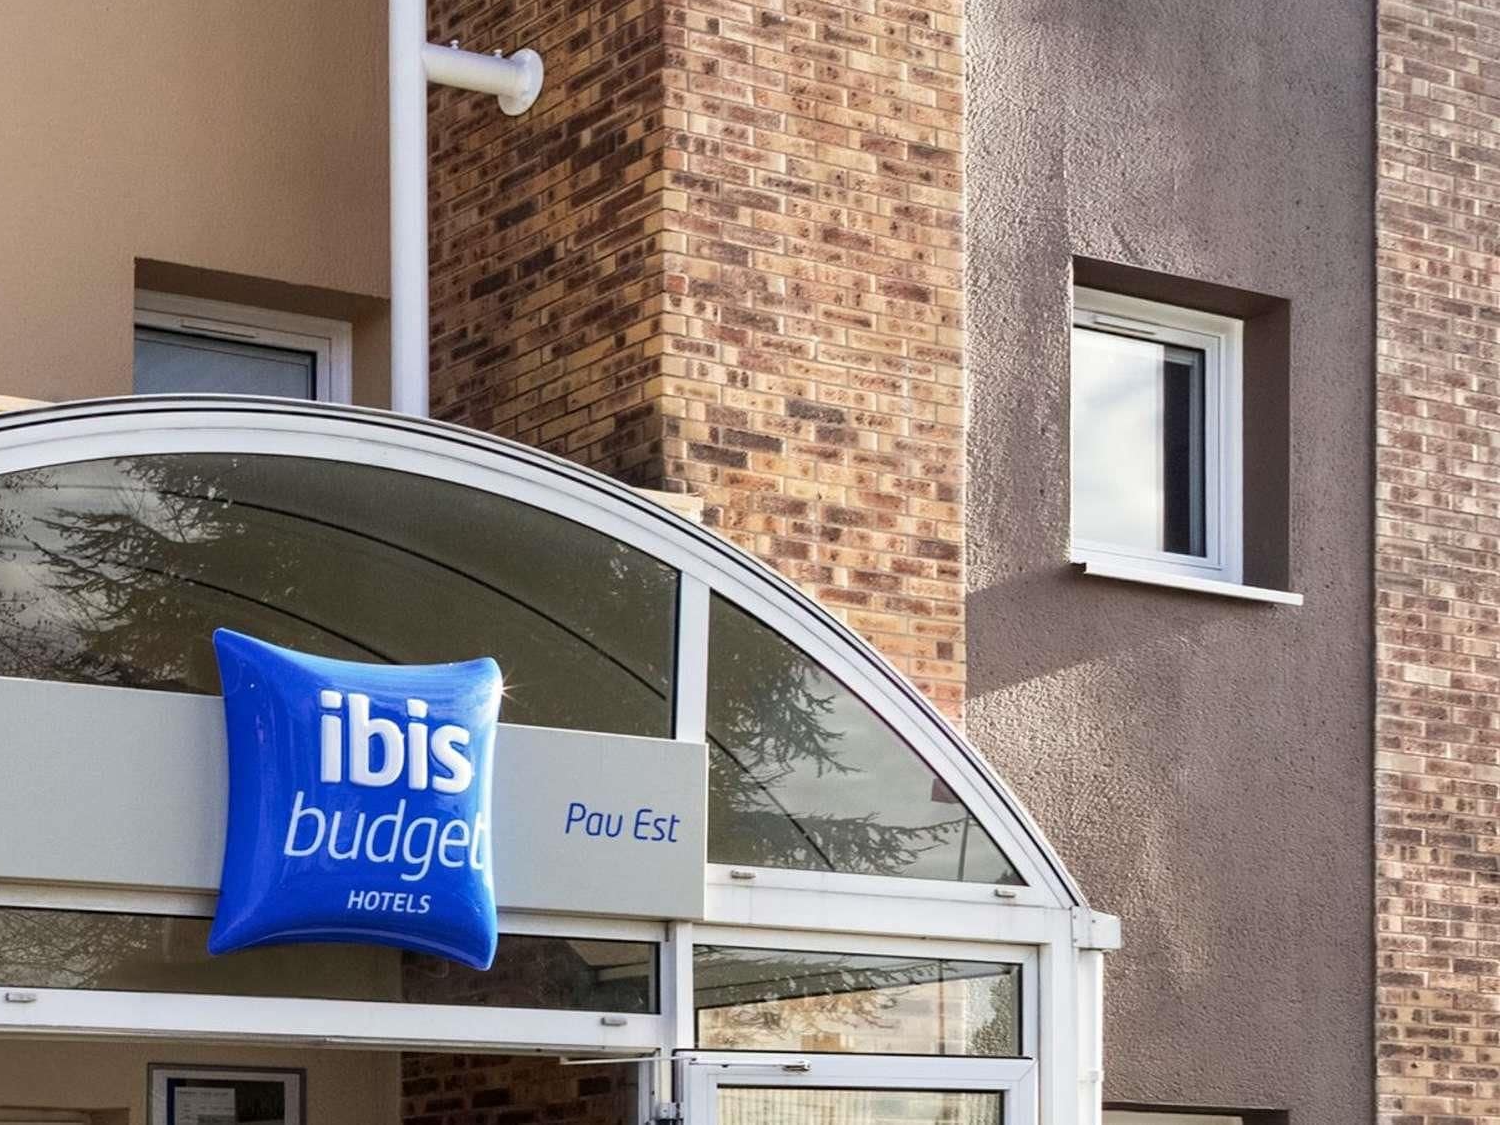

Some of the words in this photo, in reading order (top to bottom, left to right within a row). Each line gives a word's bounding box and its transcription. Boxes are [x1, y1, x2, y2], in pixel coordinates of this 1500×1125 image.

[319, 691, 474, 794] ibis
[284, 791, 490, 881] budget
[565, 803, 621, 837] Pau
[633, 809, 680, 843] Est
[347, 889, 432, 914] HOTELS
